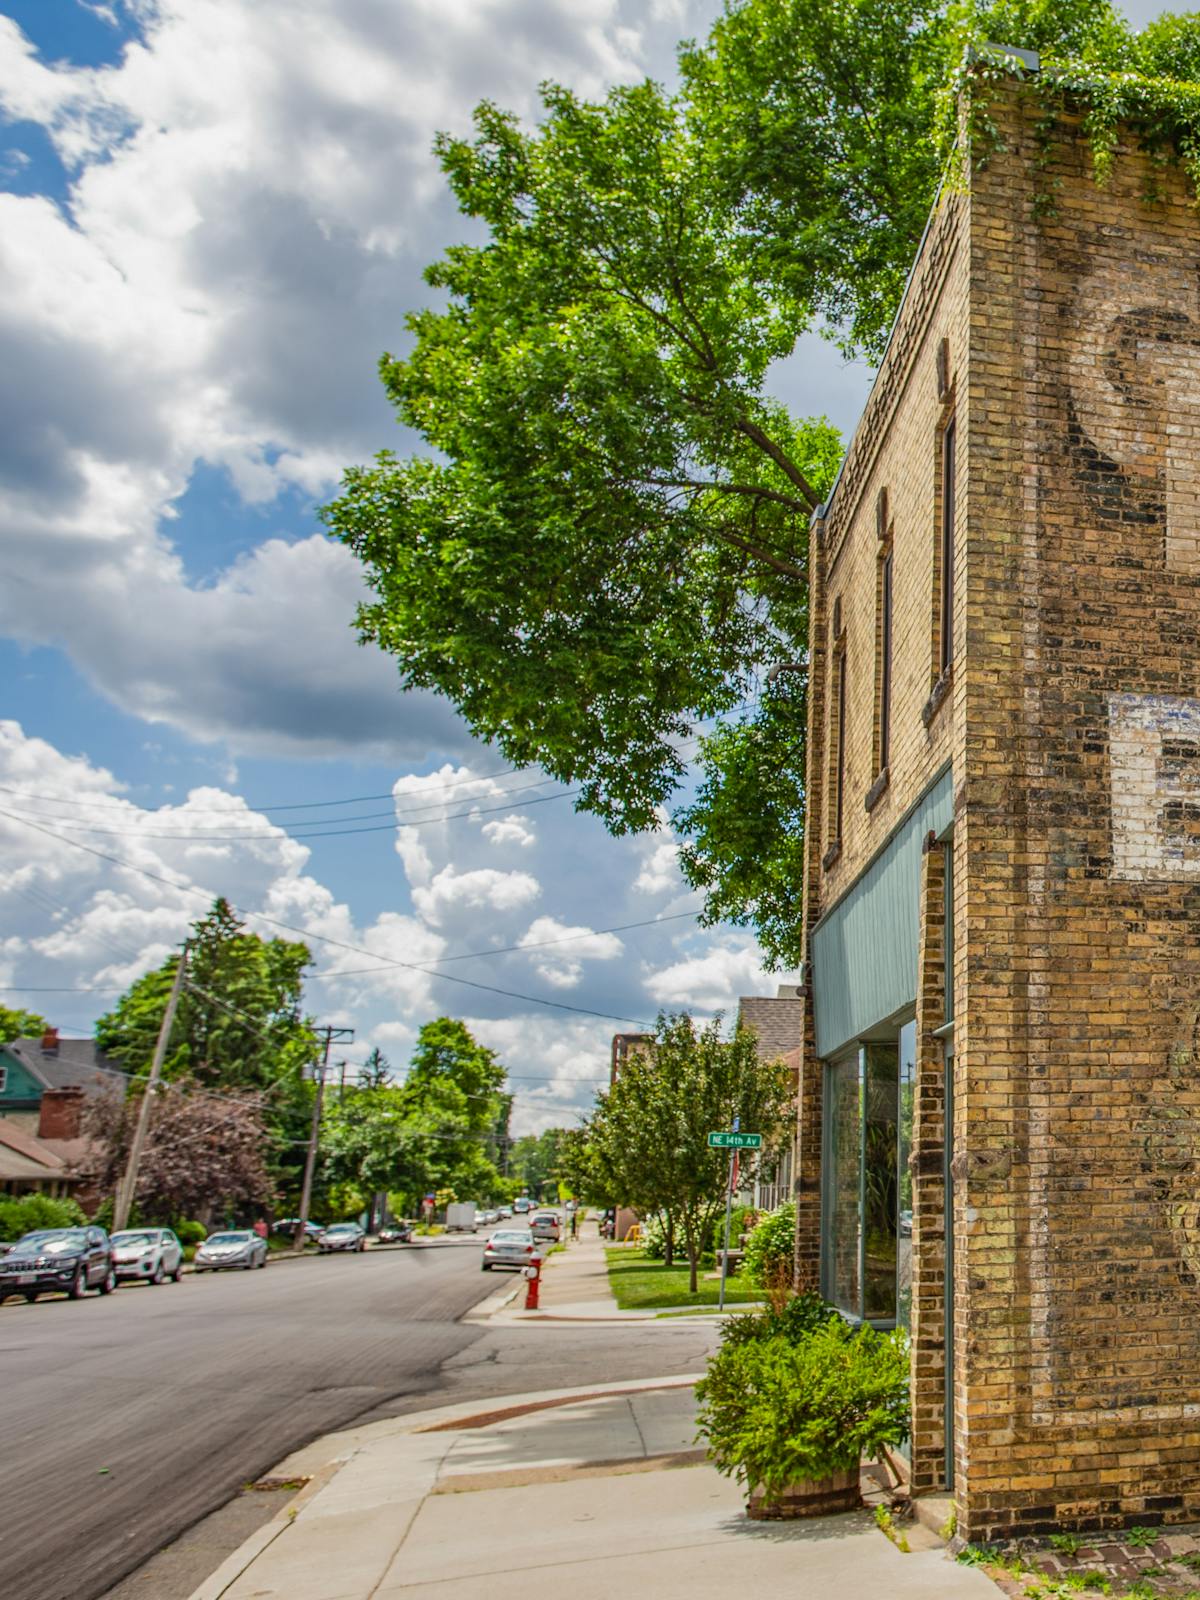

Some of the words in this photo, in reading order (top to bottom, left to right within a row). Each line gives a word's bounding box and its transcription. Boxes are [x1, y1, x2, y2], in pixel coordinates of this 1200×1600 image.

[712, 1136, 723, 1145] NE
[726, 1136, 743, 1145] 14th
[746, 1137, 757, 1146] Av
